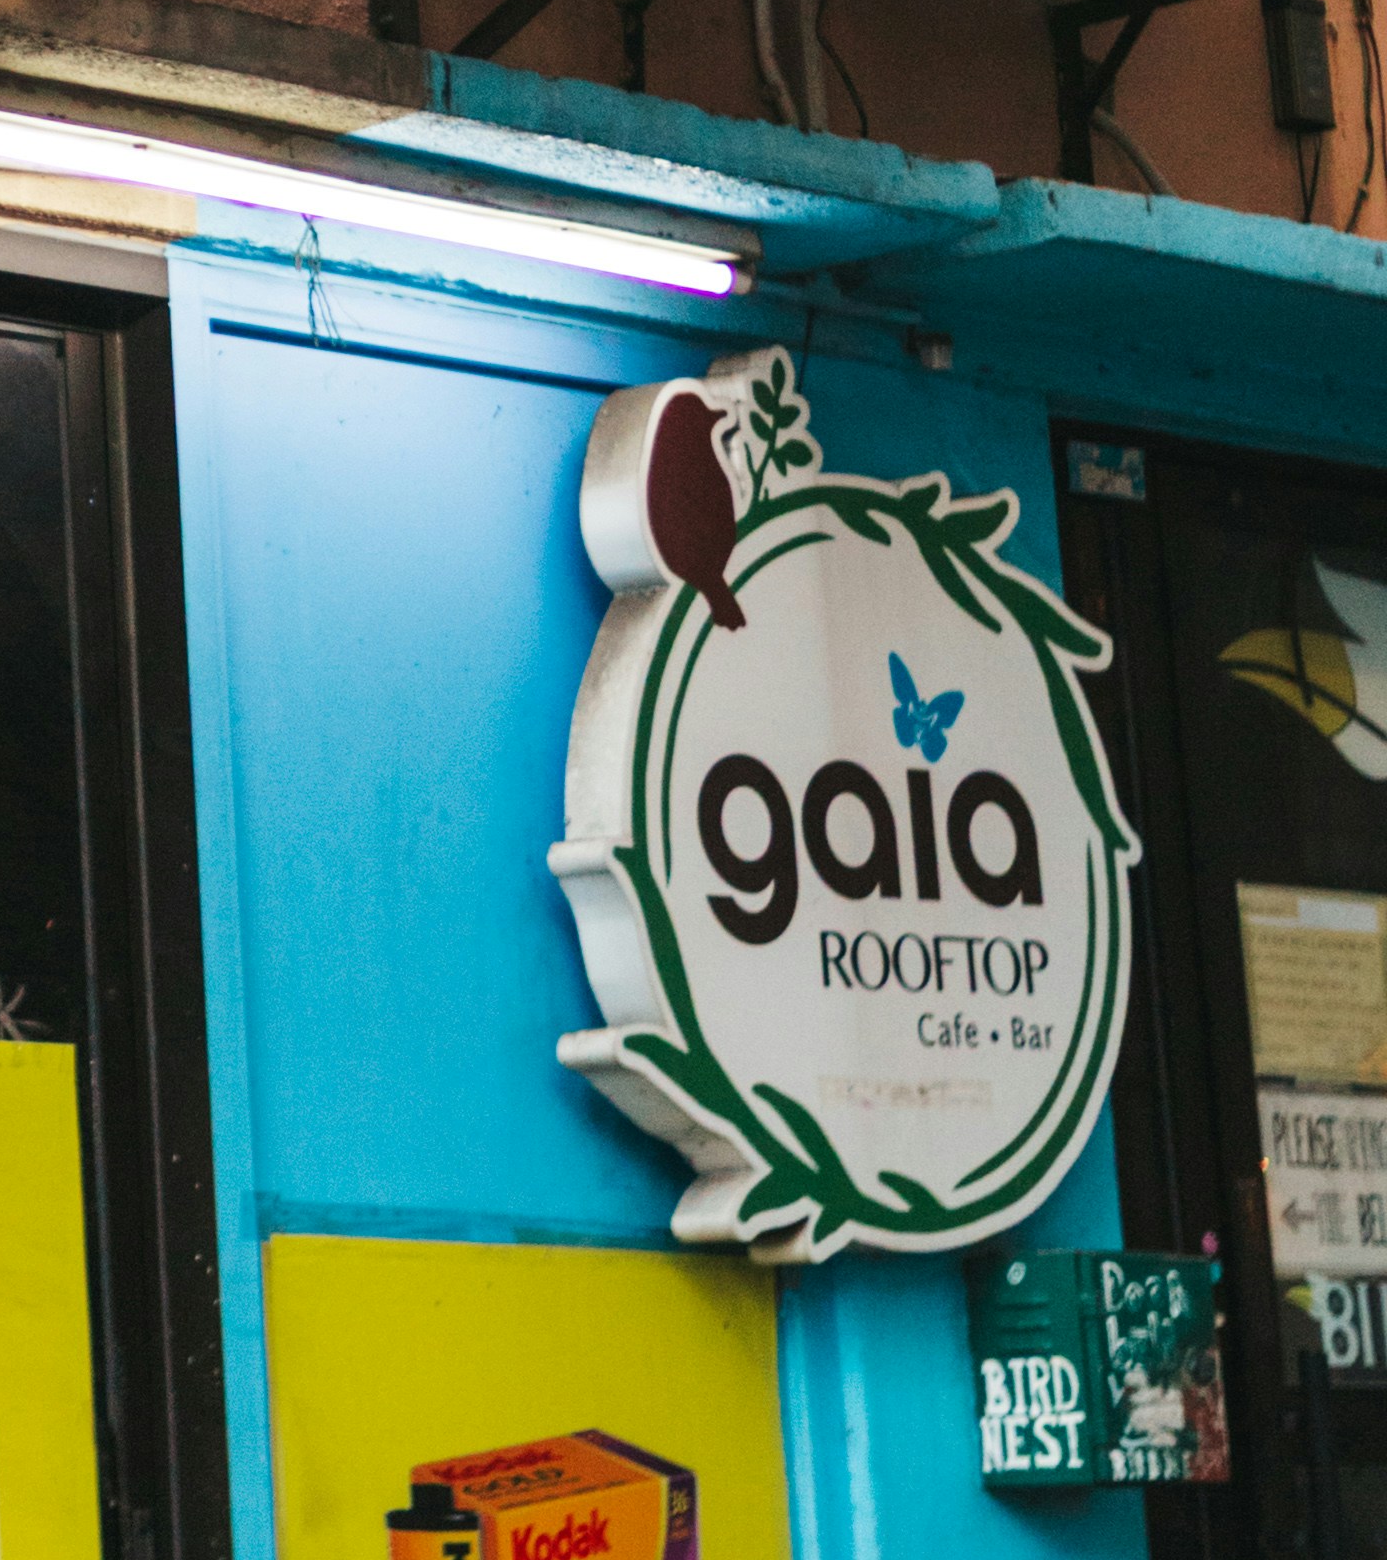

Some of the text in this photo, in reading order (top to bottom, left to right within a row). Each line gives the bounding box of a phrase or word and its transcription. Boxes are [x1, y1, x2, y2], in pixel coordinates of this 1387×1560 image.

[697, 753, 1043, 946] gaia
[820, 930, 1050, 997] ROOFTOP
[917, 1012, 1055, 1051] Cafe Bar
[981, 1354, 1079, 1419] BIRD
[980, 1410, 1086, 1474] NEST
